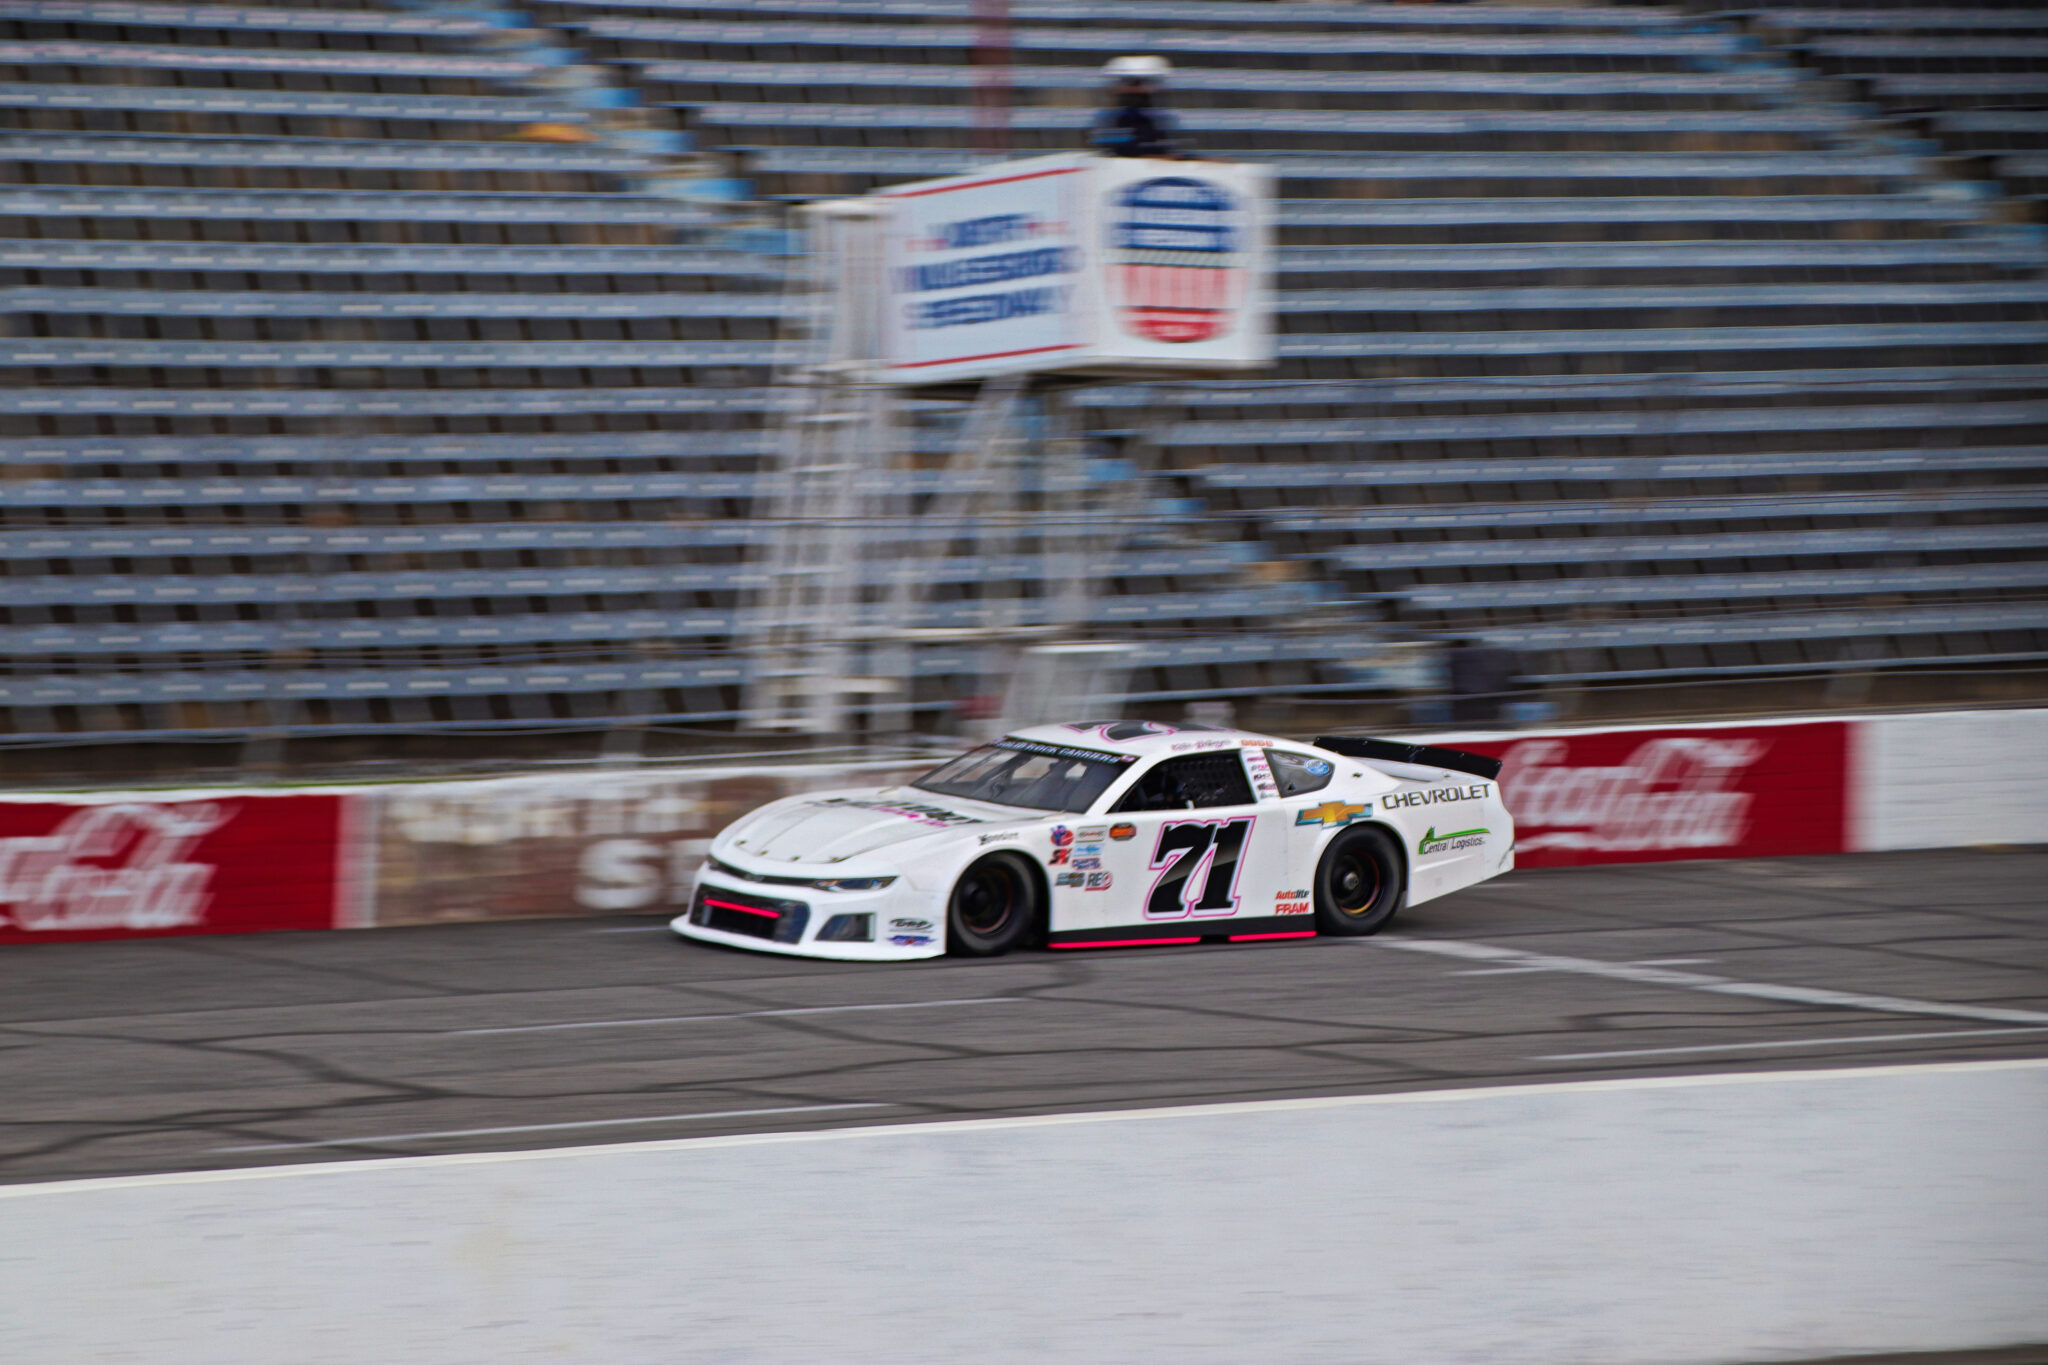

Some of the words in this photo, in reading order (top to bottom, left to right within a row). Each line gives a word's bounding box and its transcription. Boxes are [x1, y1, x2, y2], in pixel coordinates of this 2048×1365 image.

[1026, 742, 1058, 754] ROCK
[1382, 783, 1491, 810] CHEVROLET
[1423, 840, 1449, 855] Central
[1451, 836, 1483, 850] Logistics
[1144, 816, 1256, 919] 71
[1275, 901, 1310, 915] FRAM
